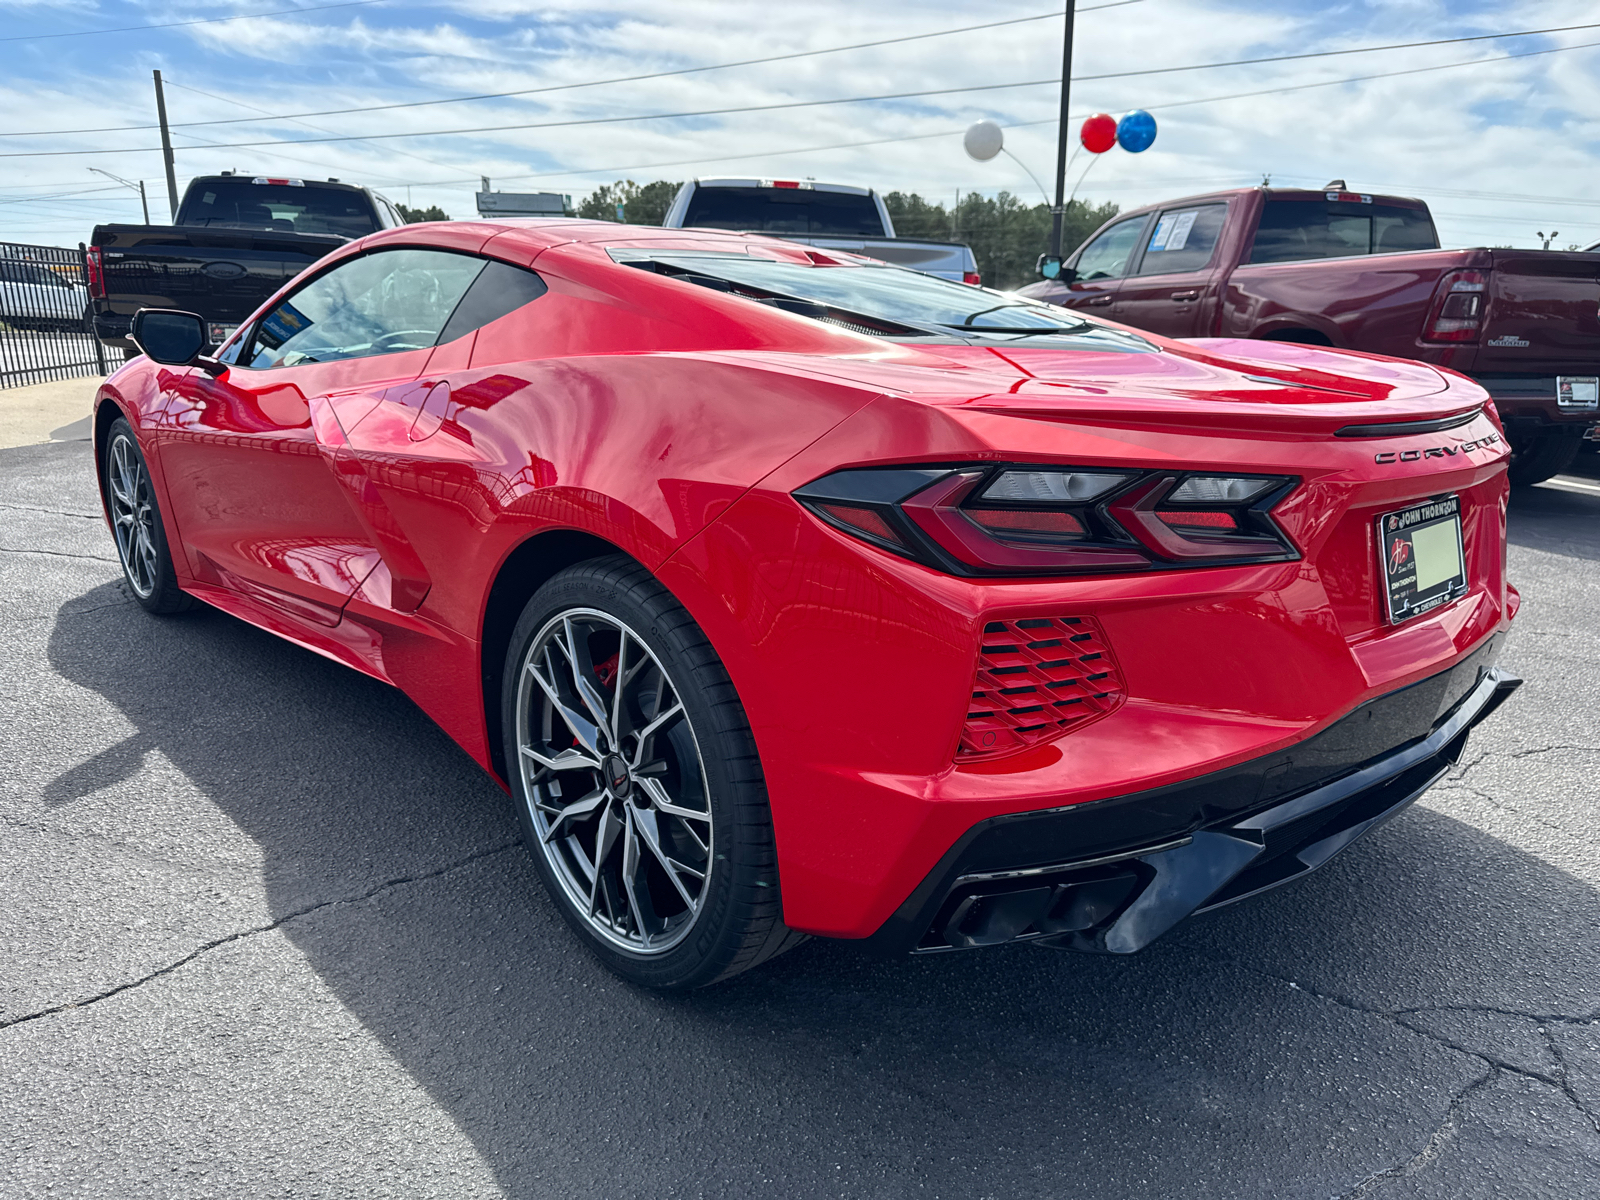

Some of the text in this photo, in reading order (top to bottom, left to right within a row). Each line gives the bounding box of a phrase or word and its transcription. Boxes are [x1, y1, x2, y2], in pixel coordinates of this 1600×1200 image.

[1375, 431, 1500, 464] CORVETTE
[1400, 499, 1457, 527] JOHN THORNTON
[563, 582, 588, 591] SEASON
[1420, 596, 1443, 612] CHEVROLET
